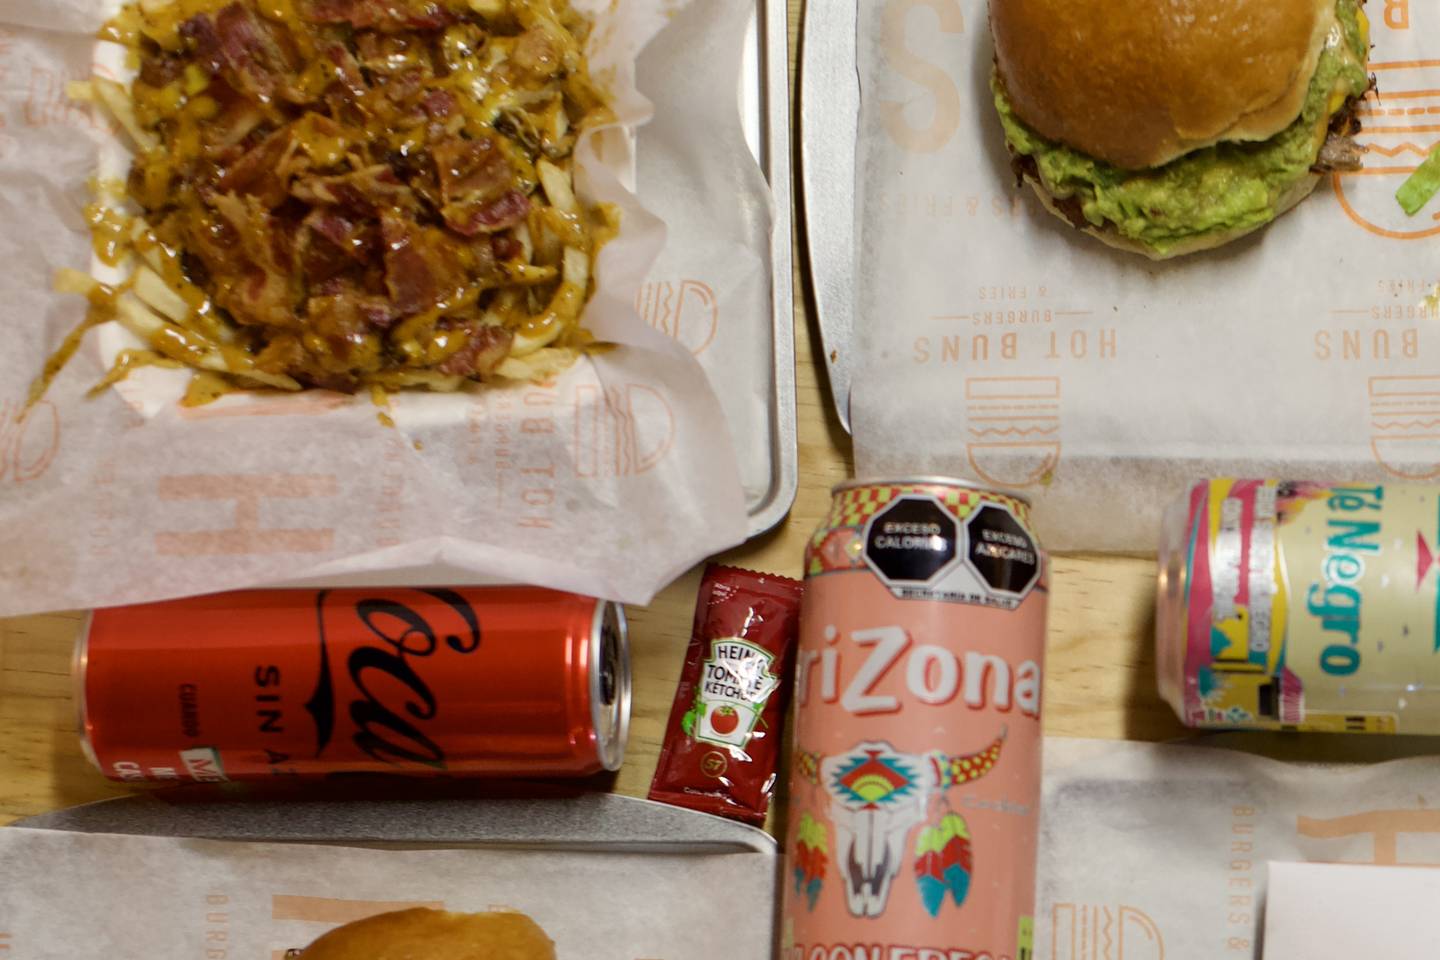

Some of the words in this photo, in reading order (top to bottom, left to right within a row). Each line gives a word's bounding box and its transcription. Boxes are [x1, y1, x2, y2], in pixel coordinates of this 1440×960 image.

[972, 309, 1053, 326] BURGERS
[912, 331, 1018, 364] BUNS
[1044, 328, 1117, 360] HOT
[1313, 327, 1420, 362] BUNS
[1327, 484, 1385, 512] Té
[883, 521, 941, 535] EXCESO
[1306, 519, 1383, 677] Negro
[717, 644, 764, 668] HEIN
[254, 665, 284, 734] SIN
[704, 680, 756, 703] KETCHU
[1228, 804, 1256, 927] BURGERS
